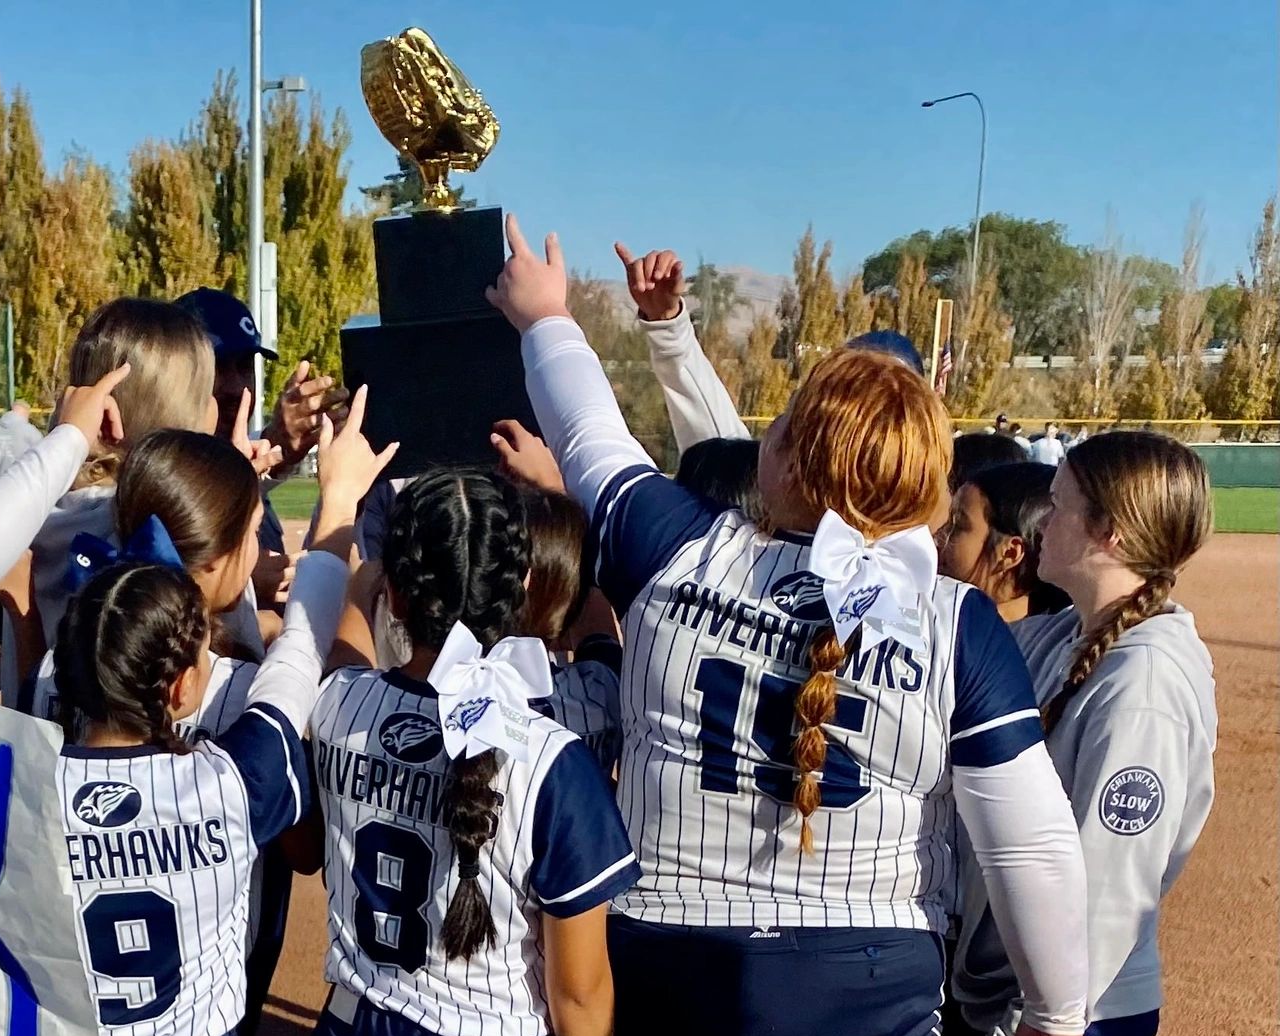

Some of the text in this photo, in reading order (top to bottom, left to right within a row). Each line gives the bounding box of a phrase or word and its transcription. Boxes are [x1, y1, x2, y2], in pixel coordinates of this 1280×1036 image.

[668, 581, 923, 693] RIVERHWKS
[319, 738, 457, 826] RIVERHAW
[690, 655, 873, 809] 15
[64, 818, 228, 883] ERHAWKS
[1106, 812, 1146, 830] PITCH
[1110, 793, 1152, 812] SLOW
[350, 819, 434, 975] 8
[81, 885, 183, 1028] 9
